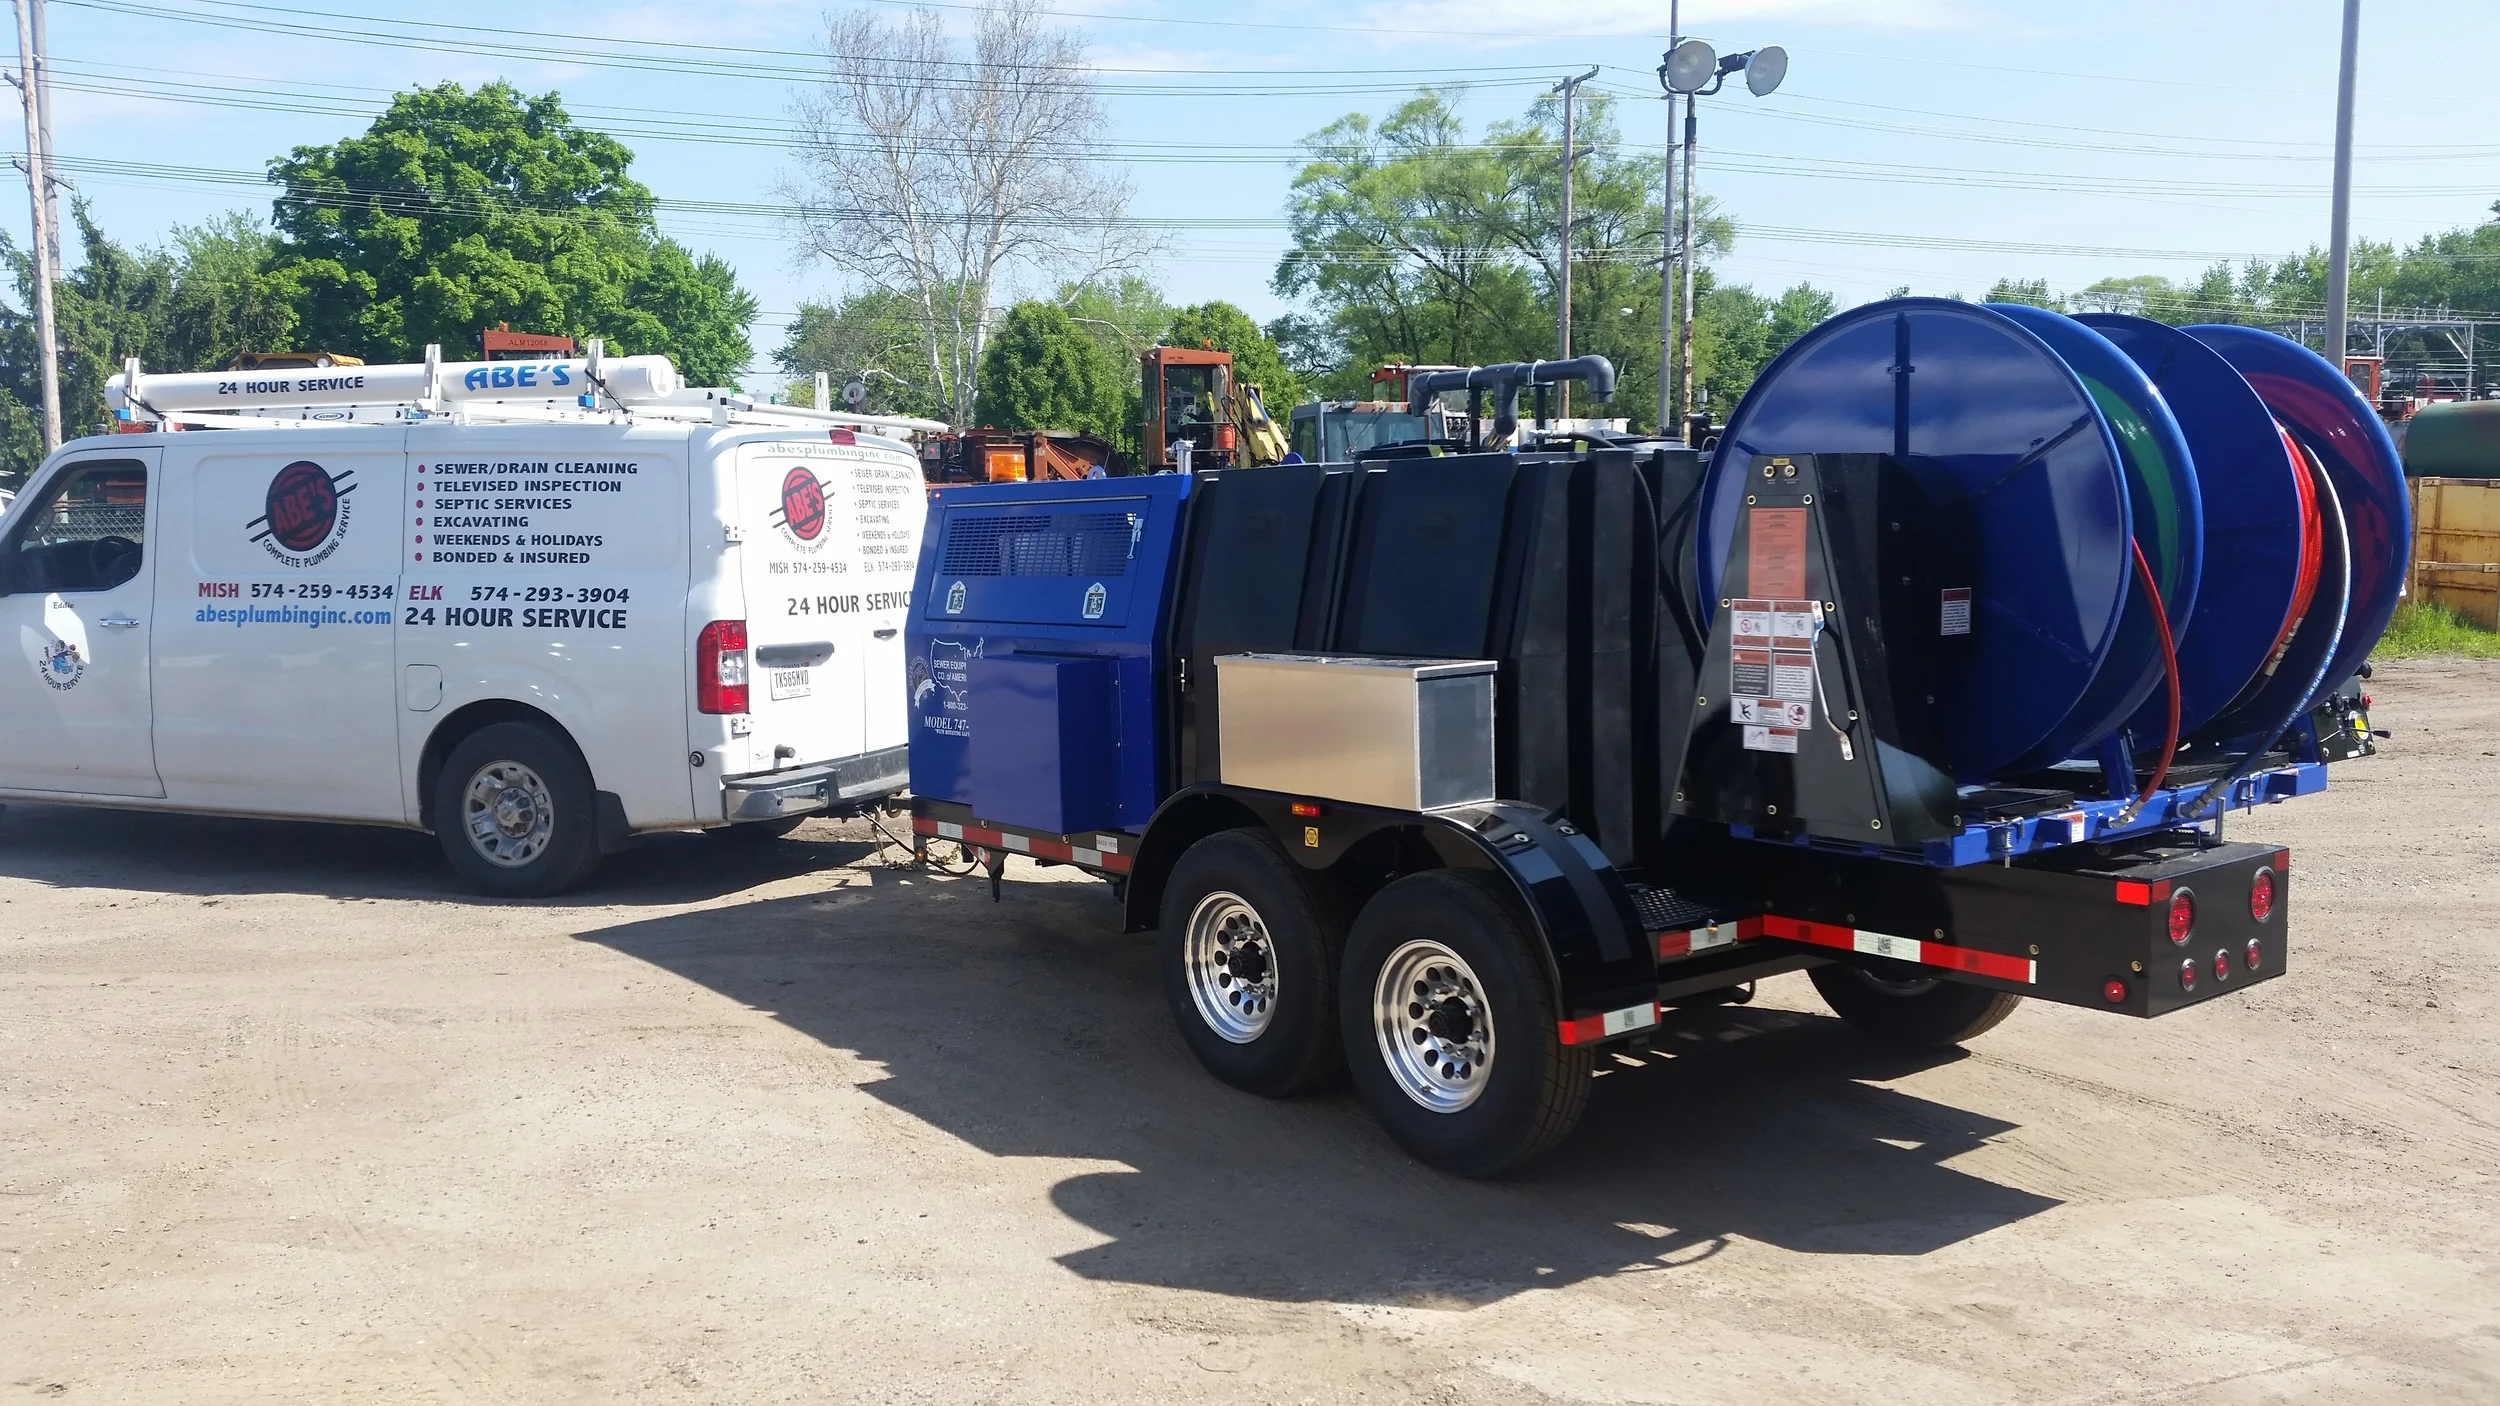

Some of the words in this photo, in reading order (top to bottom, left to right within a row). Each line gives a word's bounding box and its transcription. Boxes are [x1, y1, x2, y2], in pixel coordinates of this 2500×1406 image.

[464, 363, 571, 392] ABE'S
[218, 381, 237, 395] 24
[246, 380, 290, 394] HOUR
[298, 377, 364, 392] SERVICE
[768, 443, 903, 460] abesplumbinginccom
[434, 462, 549, 476] SEWER/DRAIN
[554, 462, 638, 474] CLEANING
[434, 481, 518, 492] TELEVISED
[524, 481, 621, 492] INSPECTION
[272, 477, 332, 533] ABE'S
[434, 499, 489, 510] SEPTIC
[494, 499, 572, 510] SERVICES
[786, 481, 823, 526] ABE'S
[433, 516, 529, 527] EXCAVATING
[263, 538, 300, 568] COMPLETE
[304, 539, 340, 567] PLUMBING
[336, 498, 350, 539] SERVICE
[433, 534, 510, 546] WEEKENDS
[516, 535, 526, 546] &
[531, 535, 603, 547] HOLIDAYS
[781, 527, 806, 554] COMPLETE
[432, 552, 497, 563] BONDED
[503, 553, 514, 563] &
[520, 552, 590, 564] INSURED
[863, 546, 883, 554] BONDED
[769, 562, 788, 574] MISH
[793, 562, 847, 574] 574-259-4534
[198, 583, 239, 598] MISH
[251, 583, 393, 599] 574-259-4534
[408, 585, 443, 601] ELK
[470, 586, 630, 603] 574-293-3904
[788, 598, 810, 616] 24
[817, 595, 860, 614] HOUR
[195, 604, 391, 629] abesplumbinginc.com
[404, 607, 435, 626] 24
[445, 607, 513, 627] HOUR
[522, 608, 627, 629] SERVICE
[933, 659, 950, 669] SEWER
[40, 660, 46, 673] 24
[43, 674, 61, 691] HOUR
[63, 664, 83, 691] SERVICE
[951, 672, 967, 682] AMERI
[924, 715, 952, 730] MODEL
